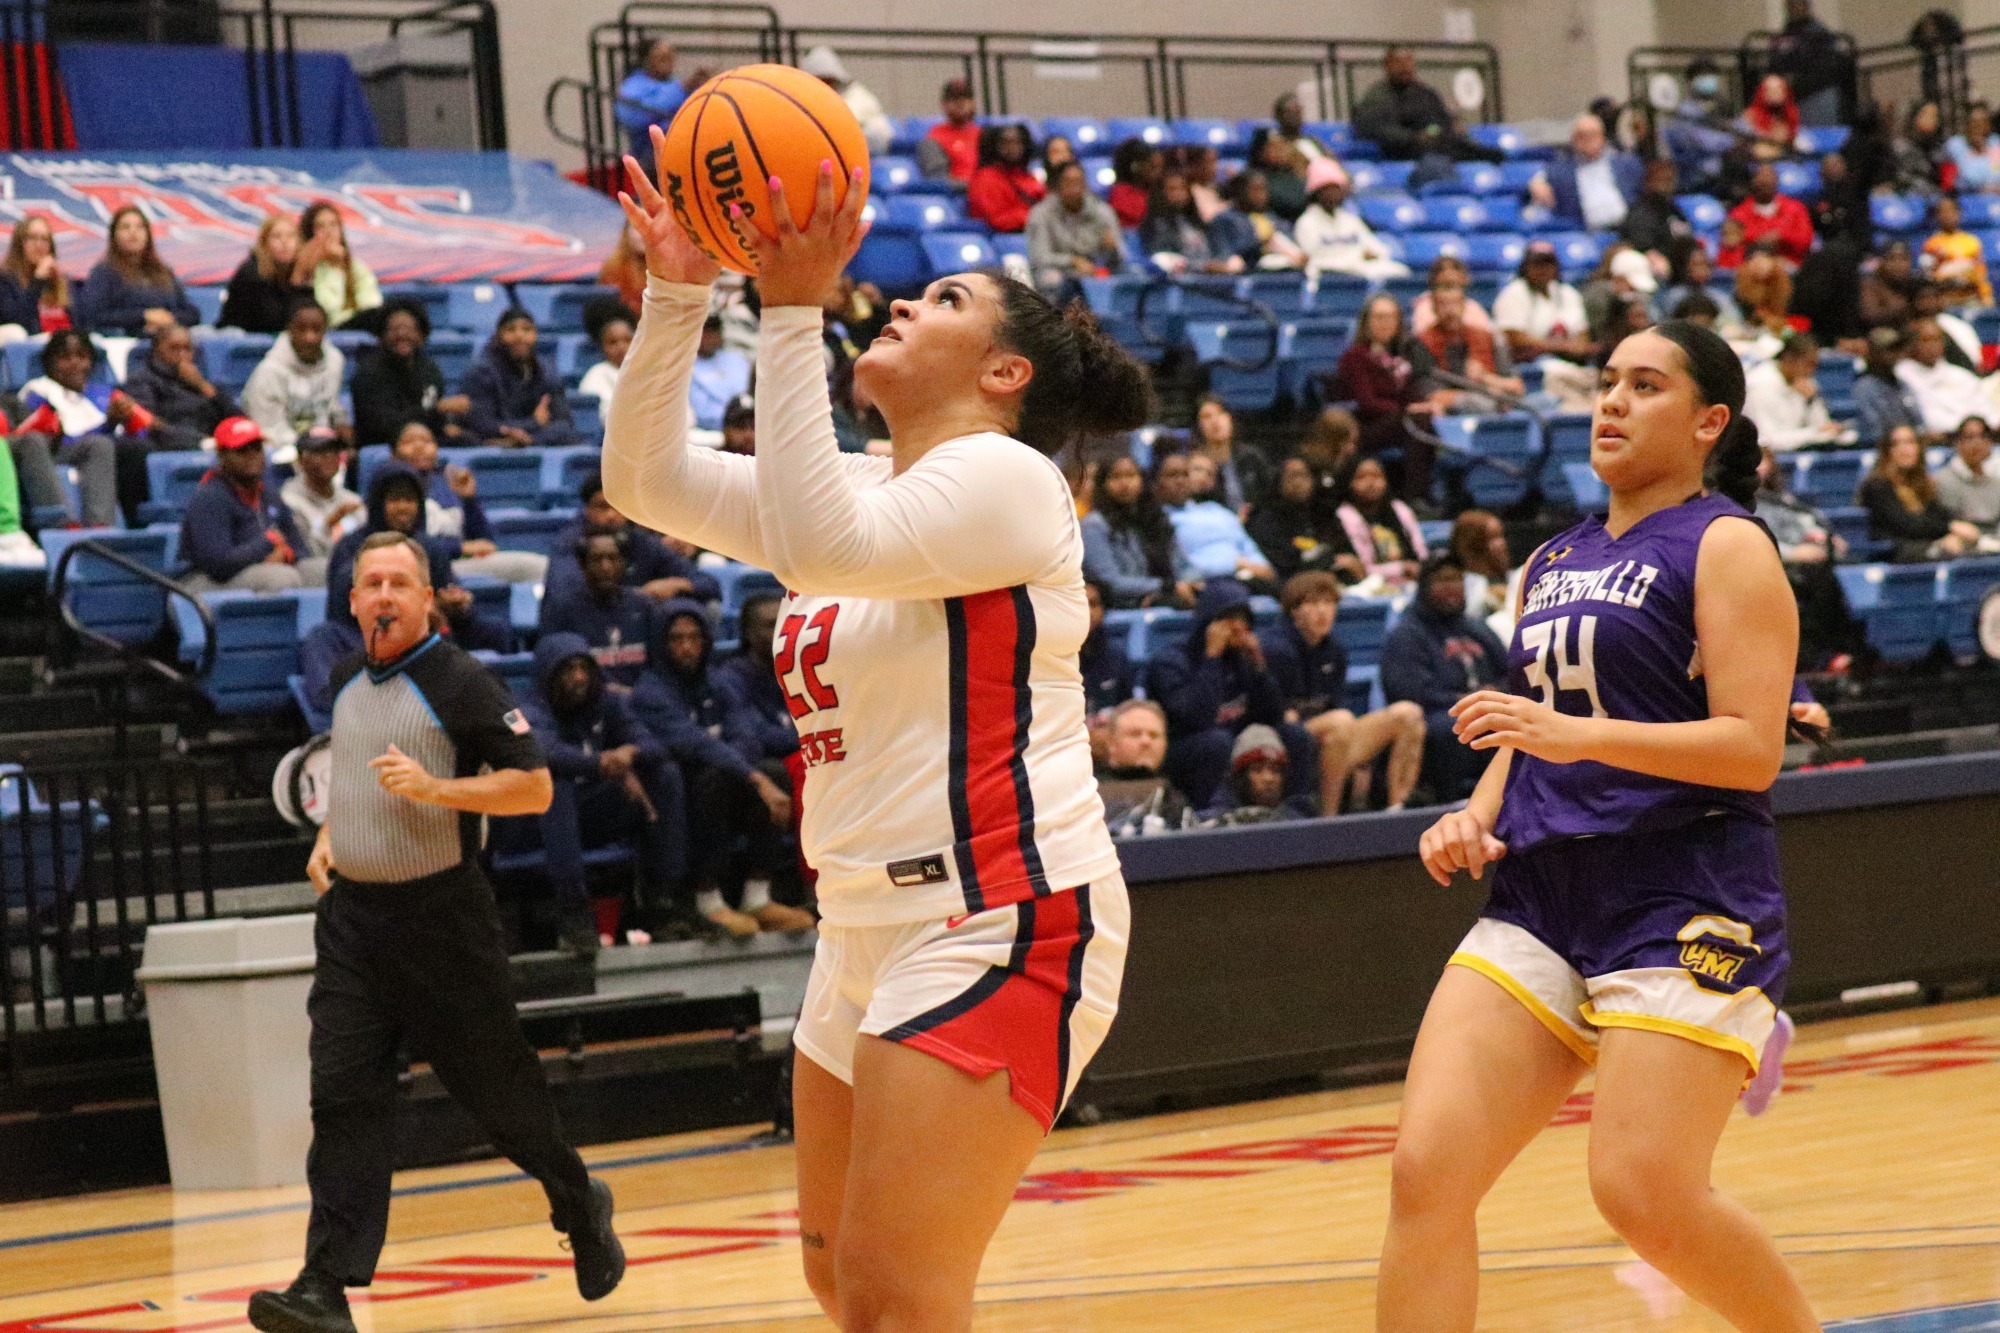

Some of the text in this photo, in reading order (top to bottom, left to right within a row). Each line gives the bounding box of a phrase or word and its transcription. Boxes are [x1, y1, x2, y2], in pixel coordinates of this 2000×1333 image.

[705, 139, 762, 267] Wil
[774, 603, 840, 721] 22
[1521, 615, 1609, 719] 34
[924, 863, 942, 877] XL
